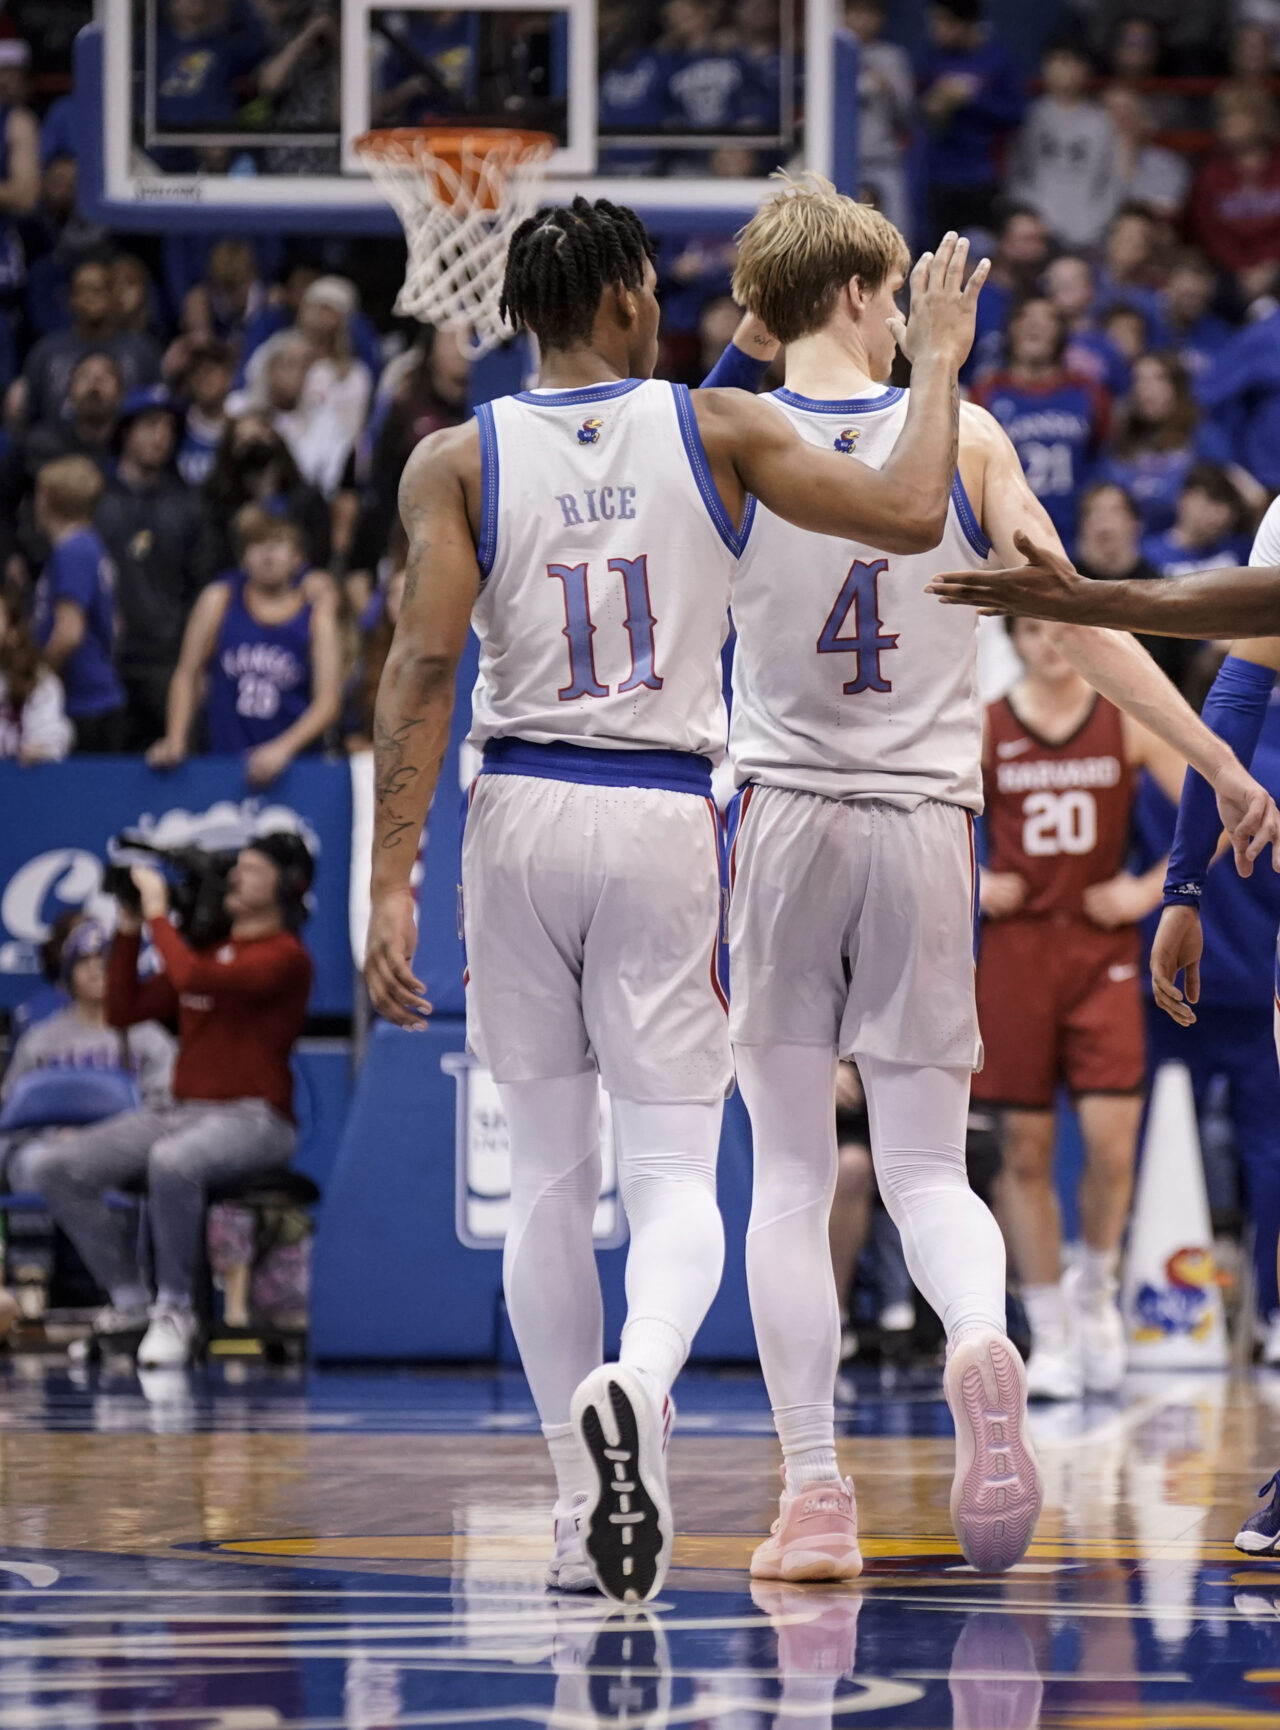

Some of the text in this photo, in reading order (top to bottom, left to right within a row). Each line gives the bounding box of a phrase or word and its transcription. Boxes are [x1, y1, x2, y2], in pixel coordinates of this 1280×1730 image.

[555, 486, 637, 528] RICE
[547, 554, 664, 702] 11
[816, 558, 901, 695] 4
[996, 756, 1121, 794] HARVARD
[1021, 789, 1098, 857] 20
